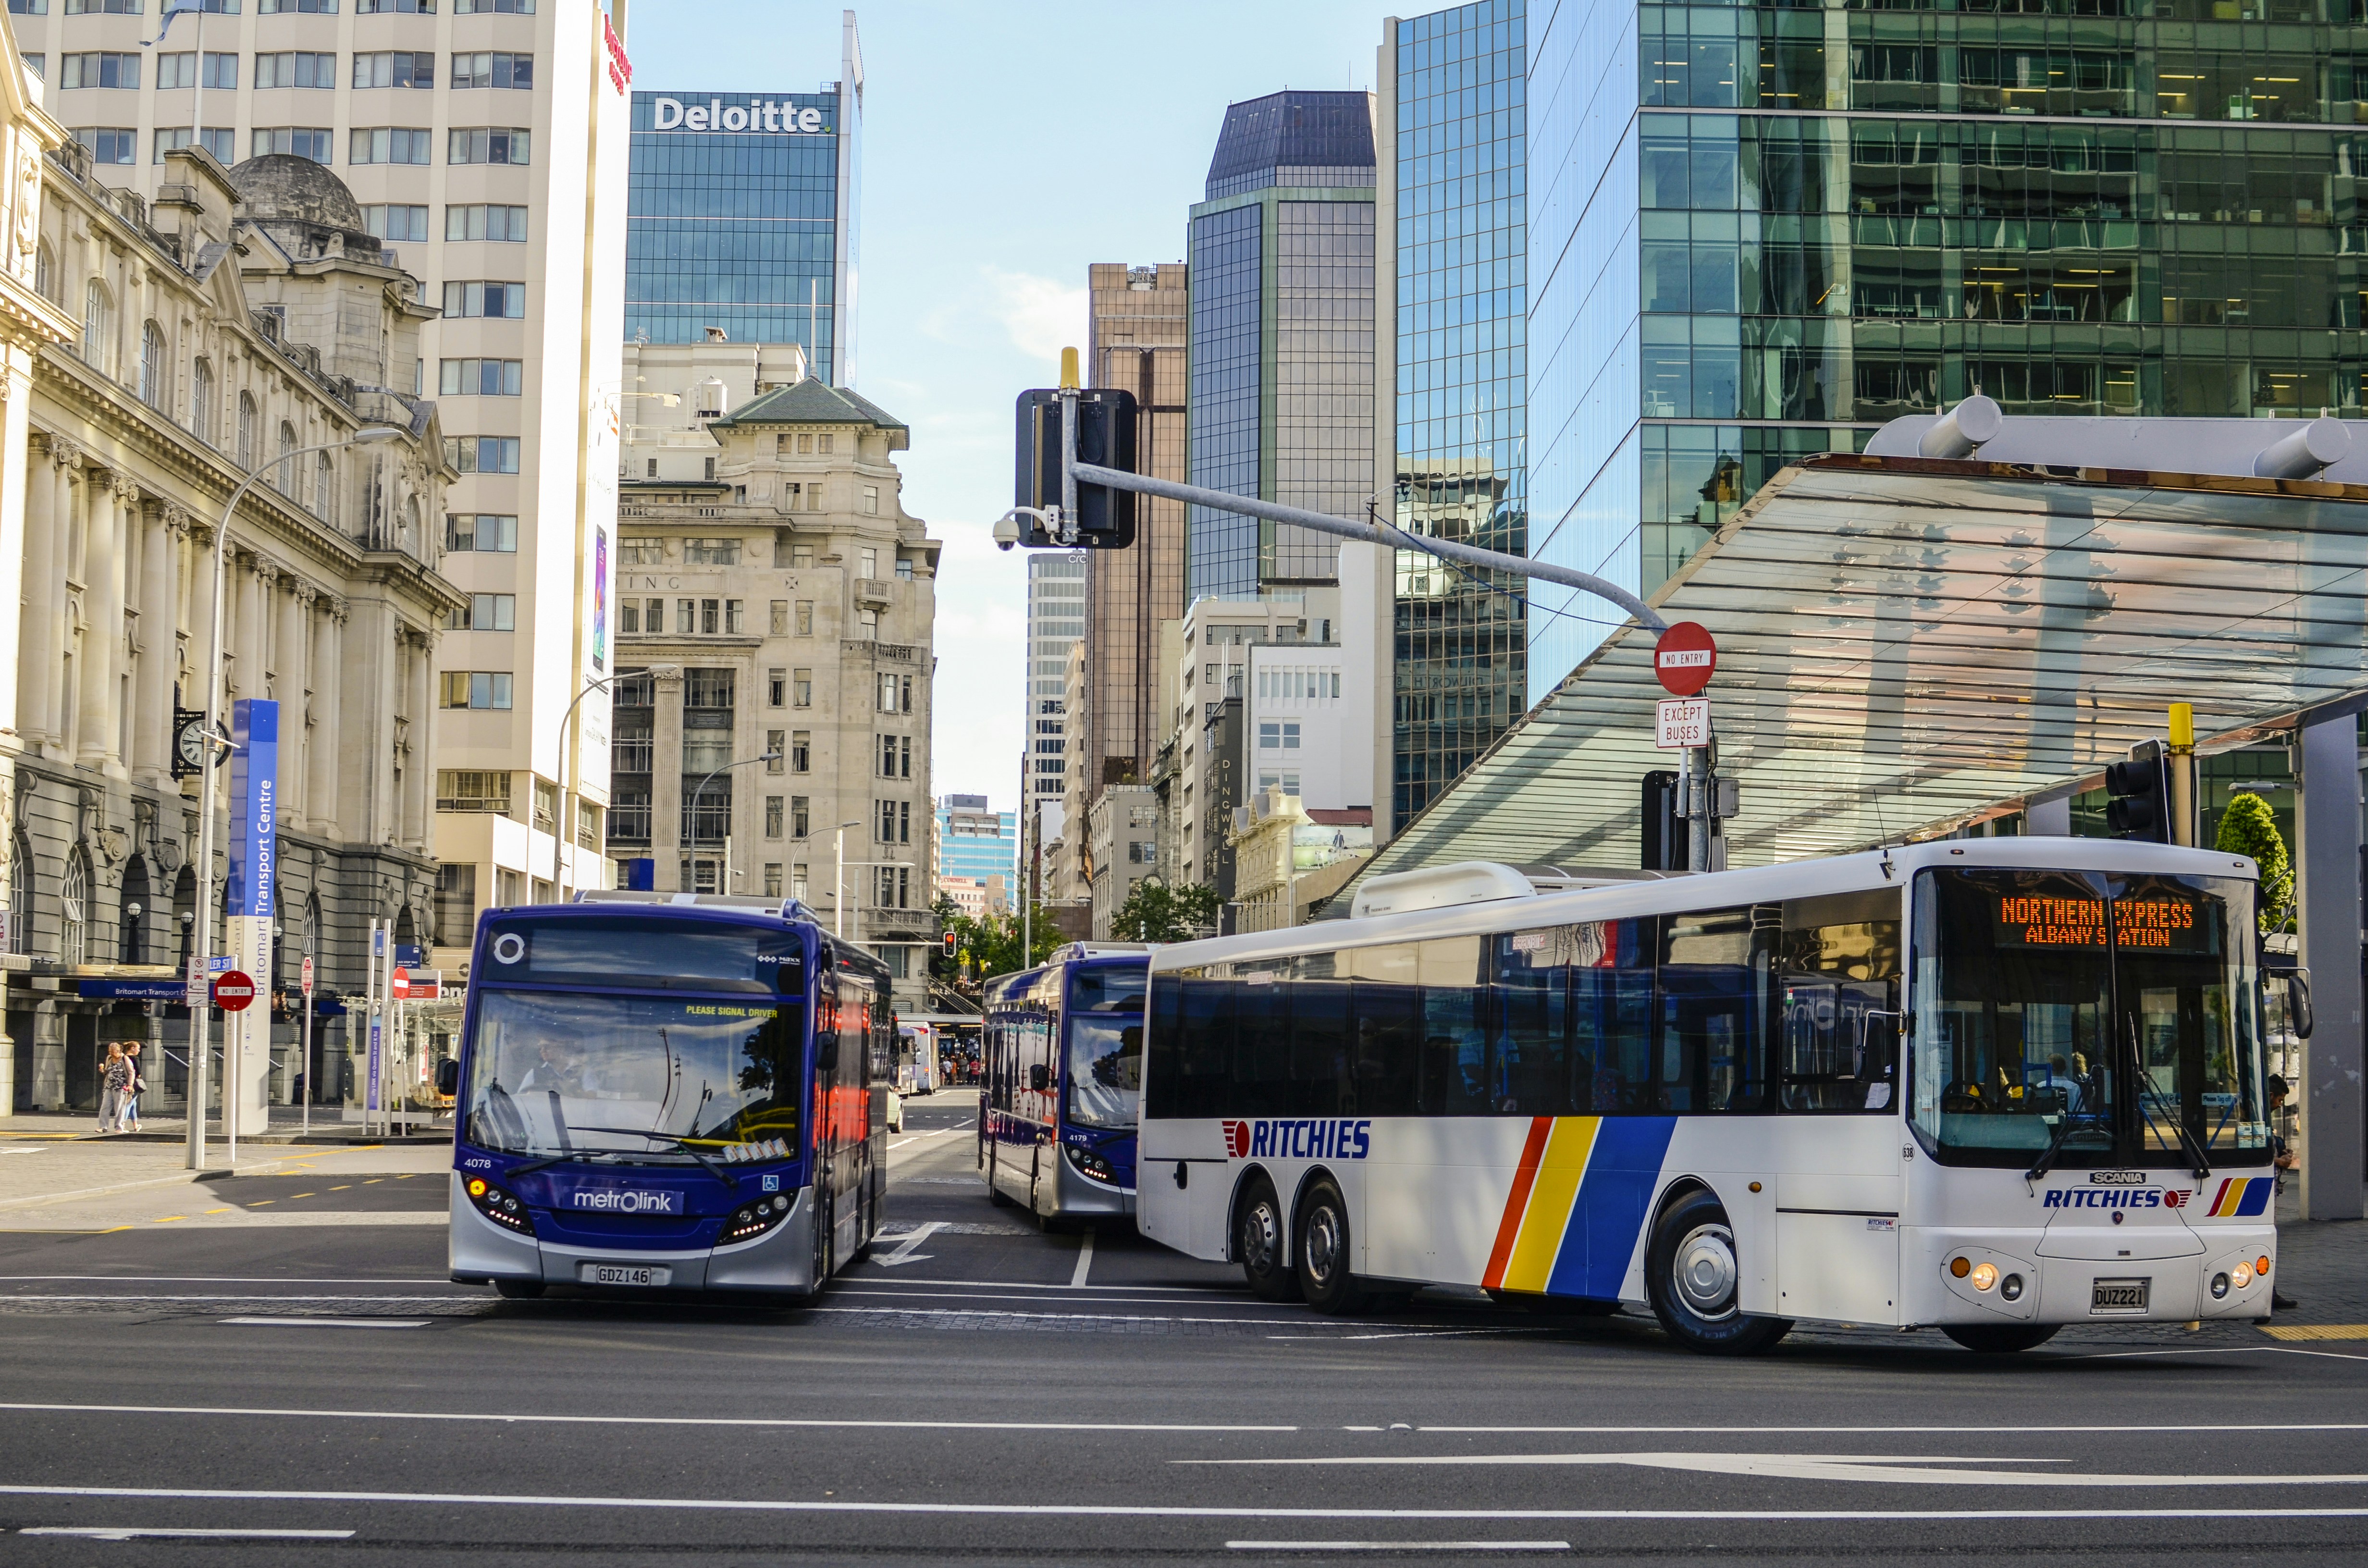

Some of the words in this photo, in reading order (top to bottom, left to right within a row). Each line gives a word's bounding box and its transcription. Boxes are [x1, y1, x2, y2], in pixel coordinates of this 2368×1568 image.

[616, 576, 679, 589] ING
[1666, 654, 1676, 665] NO
[1681, 653, 1703, 664] ENTRY
[1665, 707, 1702, 722] EXCEPT
[1666, 725, 1699, 740] BUSES
[257, 779, 272, 833] Centre
[1221, 760, 1231, 864] DINGWALL
[255, 838, 271, 914] Transport
[2002, 897, 2103, 925] NORTHERN
[1513, 937, 1531, 949] EMERGENCY
[2025, 925, 2093, 944] ALBANY
[2097, 927, 2170, 946] SATION
[222, 958, 230, 968] ST
[254, 919, 267, 996] Britomart
[686, 1005, 716, 1015] PLEASE
[718, 1007, 746, 1017] SIGNAL
[748, 1008, 778, 1018] DRIVER
[1251, 1120, 1371, 1159] RITCHIES
[1903, 1147, 1913, 1158] 638
[464, 1158, 491, 1168] 4078
[2094, 1172, 2143, 1183] SCANIA
[2043, 1189, 2161, 1208] RITCHIES
[598, 1268, 649, 1283] GDZ146
[2096, 1289, 2142, 1304] DUZ221
